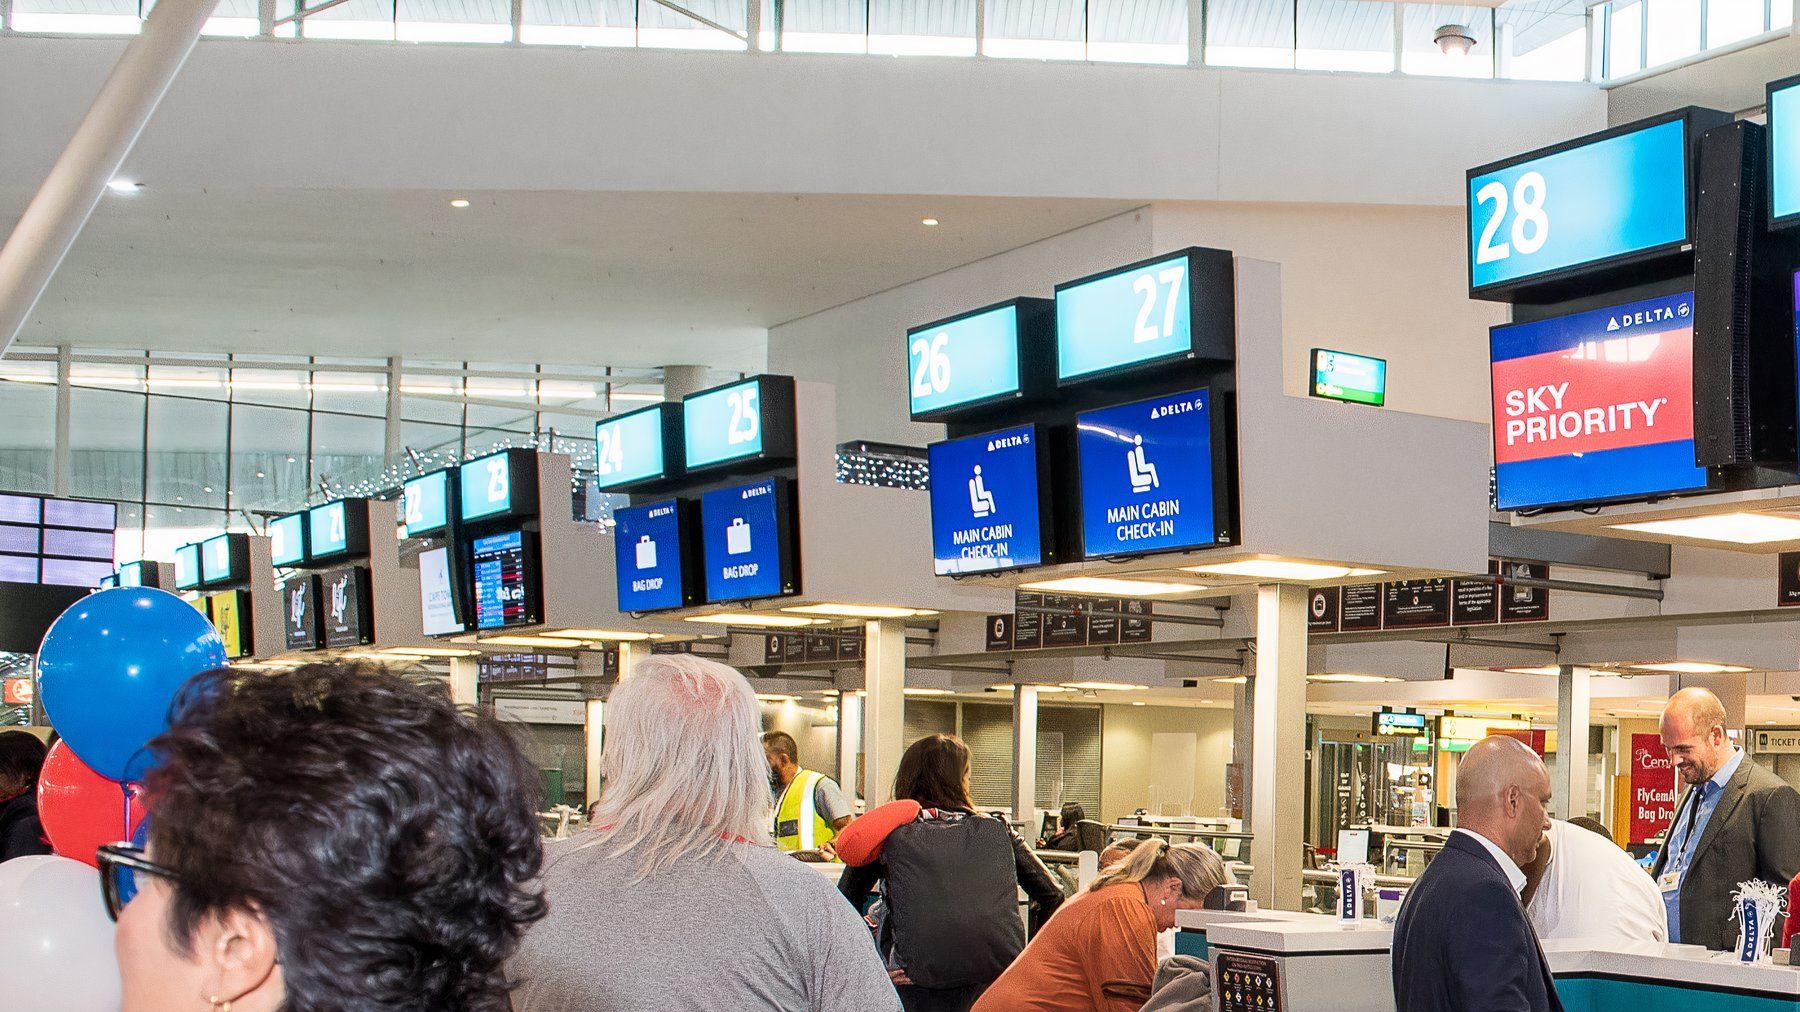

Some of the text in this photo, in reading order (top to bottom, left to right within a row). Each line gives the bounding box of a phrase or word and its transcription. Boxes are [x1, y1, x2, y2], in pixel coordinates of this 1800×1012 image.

[1475, 171, 1550, 264] 28
[1133, 266, 1185, 344] 27
[1622, 306, 1674, 329] DELTA
[911, 332, 951, 398] 26
[1160, 402, 1194, 416] DELTA
[1505, 381, 1569, 415] SKY
[727, 388, 758, 445] 25
[1505, 402, 1659, 446] PRIORITY
[598, 424, 623, 475] 24
[995, 436, 1023, 450] DELTA
[487, 457, 509, 502] 23
[748, 486, 767, 498] DELTA
[654, 506, 670, 517] DELTA
[1107, 500, 1180, 523] MAIN CABIN
[953, 524, 1012, 546] MAIN CABIN
[1116, 520, 1174, 542] CHECK-IN
[961, 542, 1009, 560] CHECK-IN
[723, 563, 759, 580] BAG DROP
[632, 578, 663, 592] BAG DROP
[1771, 738, 1796, 747] TICKET
[1637, 787, 1674, 805] FlyCemA
[1638, 807, 1674, 823] Bag Dro
